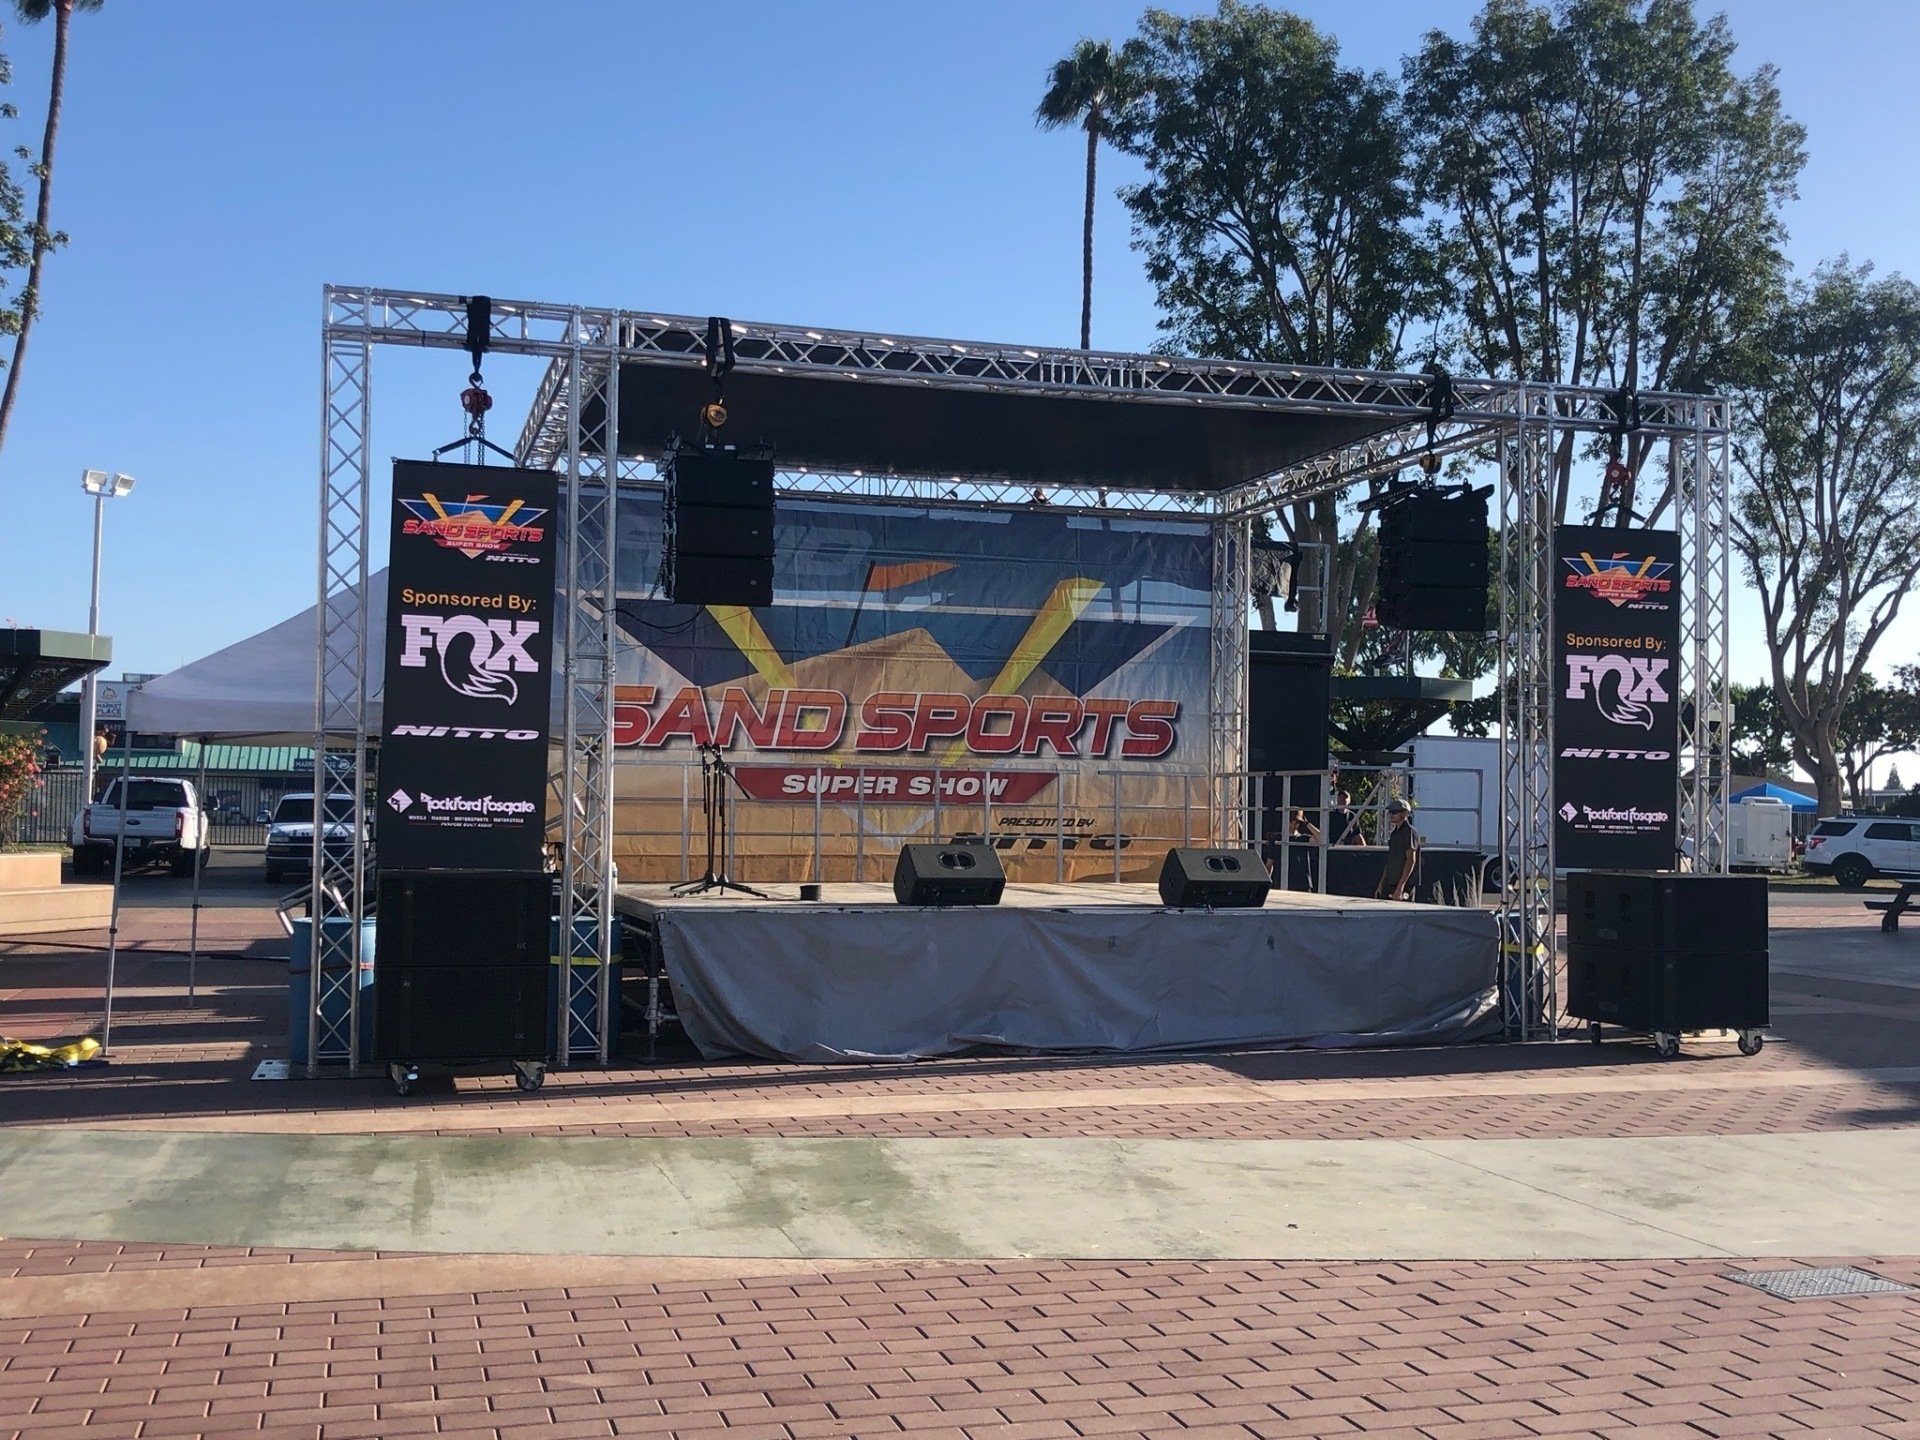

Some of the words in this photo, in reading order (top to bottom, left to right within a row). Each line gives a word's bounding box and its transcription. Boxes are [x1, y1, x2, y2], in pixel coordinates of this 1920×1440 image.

[403, 519, 463, 538] SAND
[463, 523, 544, 542] SPORTS
[485, 555, 540, 563] NITTO
[1566, 574, 1611, 589] SAND
[1611, 577, 1671, 593] SPORTS
[402, 588, 502, 608] Sponsored
[508, 595, 536, 613] By:
[1566, 633, 1641, 648] Sponsored
[1645, 637, 1667, 652] By:
[400, 614, 540, 706] FOX
[1566, 654, 1669, 731] FOX
[613, 685, 848, 749] SAND
[855, 691, 1178, 757] SPORTS
[390, 725, 540, 740] NITTO
[1560, 748, 1671, 760] NITTO
[781, 774, 898, 795] SUPER
[908, 776, 1009, 796] SHOW
[420, 792, 482, 813] Rockford
[1583, 805, 1628, 822] Rockford
